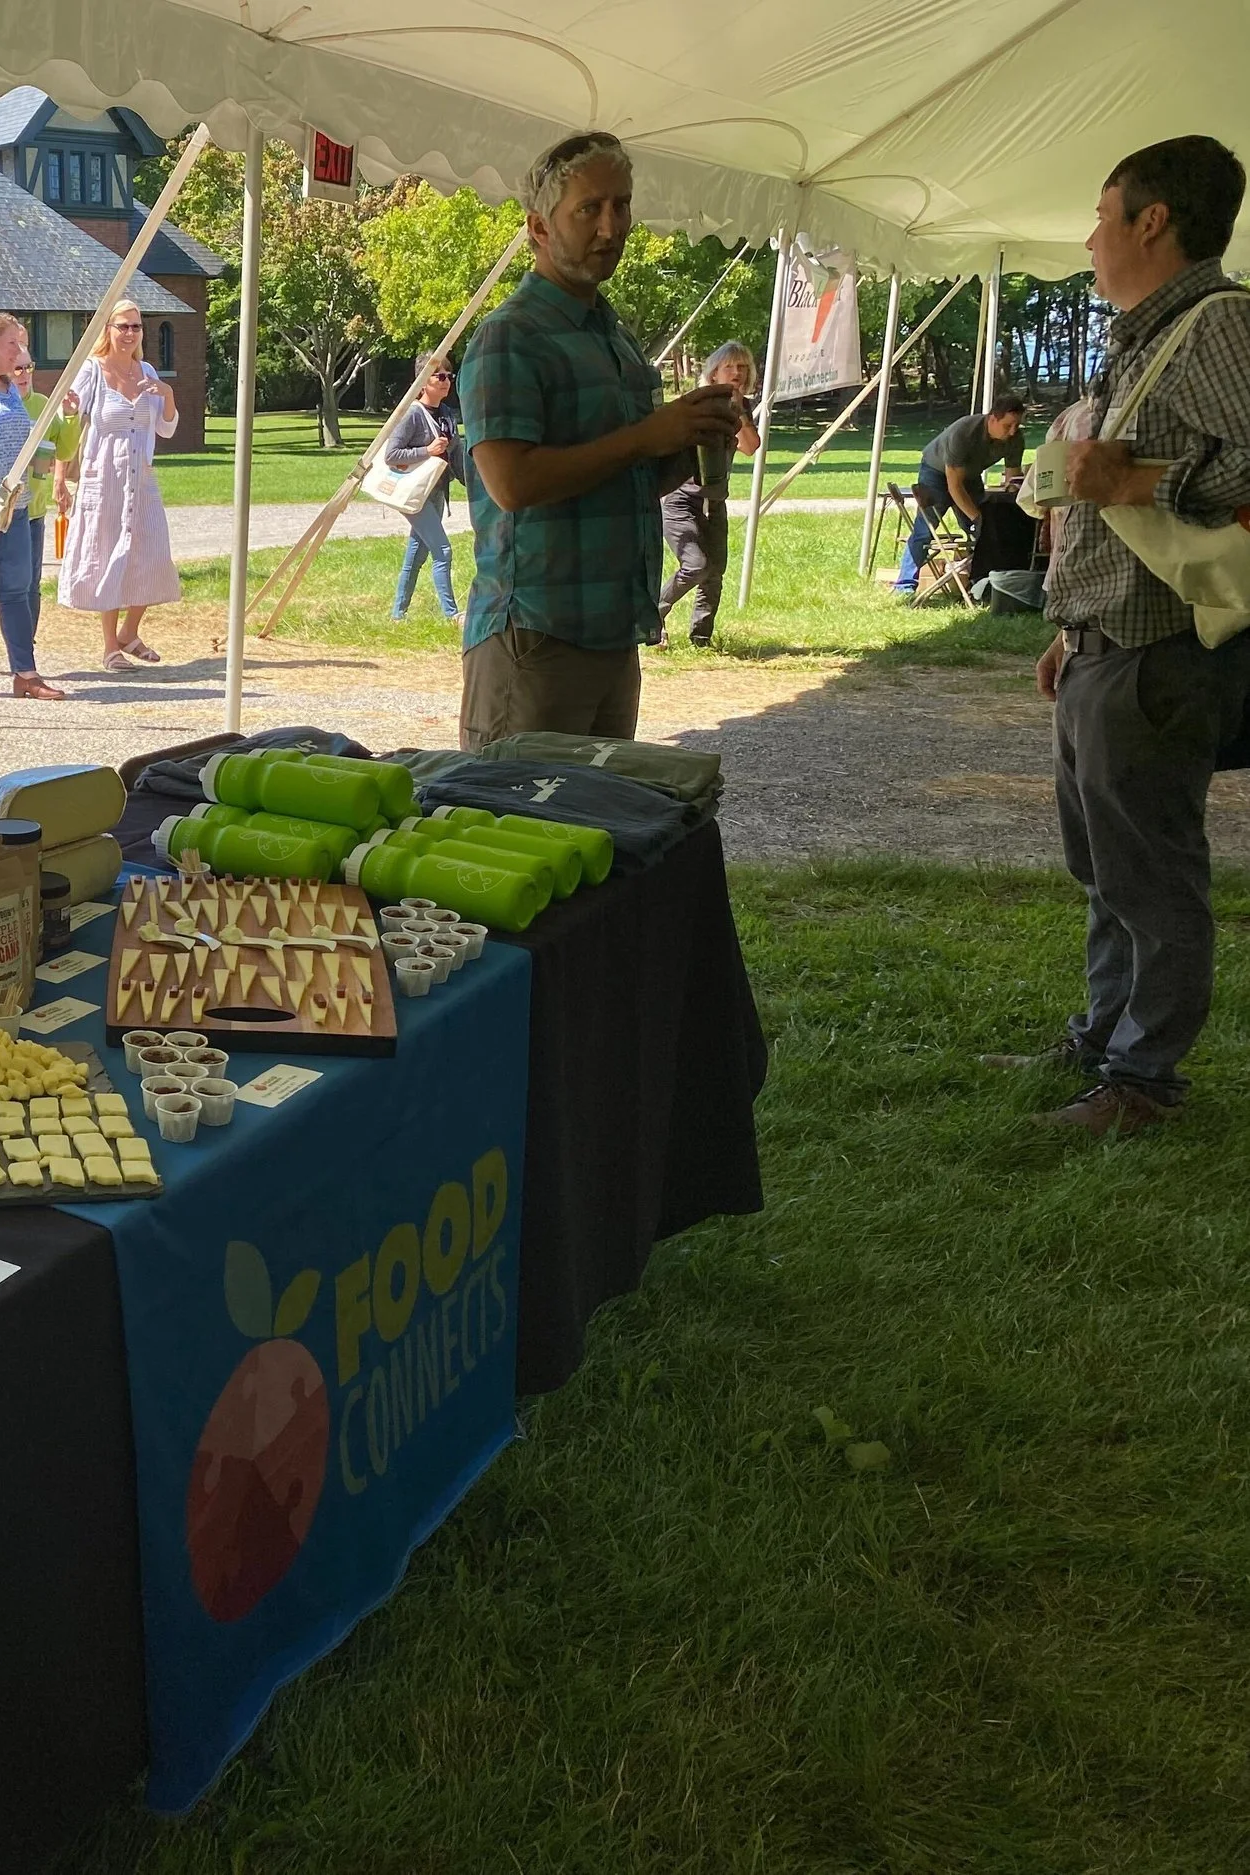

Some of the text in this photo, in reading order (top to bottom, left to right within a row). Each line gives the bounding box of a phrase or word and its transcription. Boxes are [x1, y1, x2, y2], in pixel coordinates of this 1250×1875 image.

[316, 133, 351, 185] EXIT
[335, 1146, 508, 1386] FOOD
[338, 1244, 507, 1495] CONNECTS
